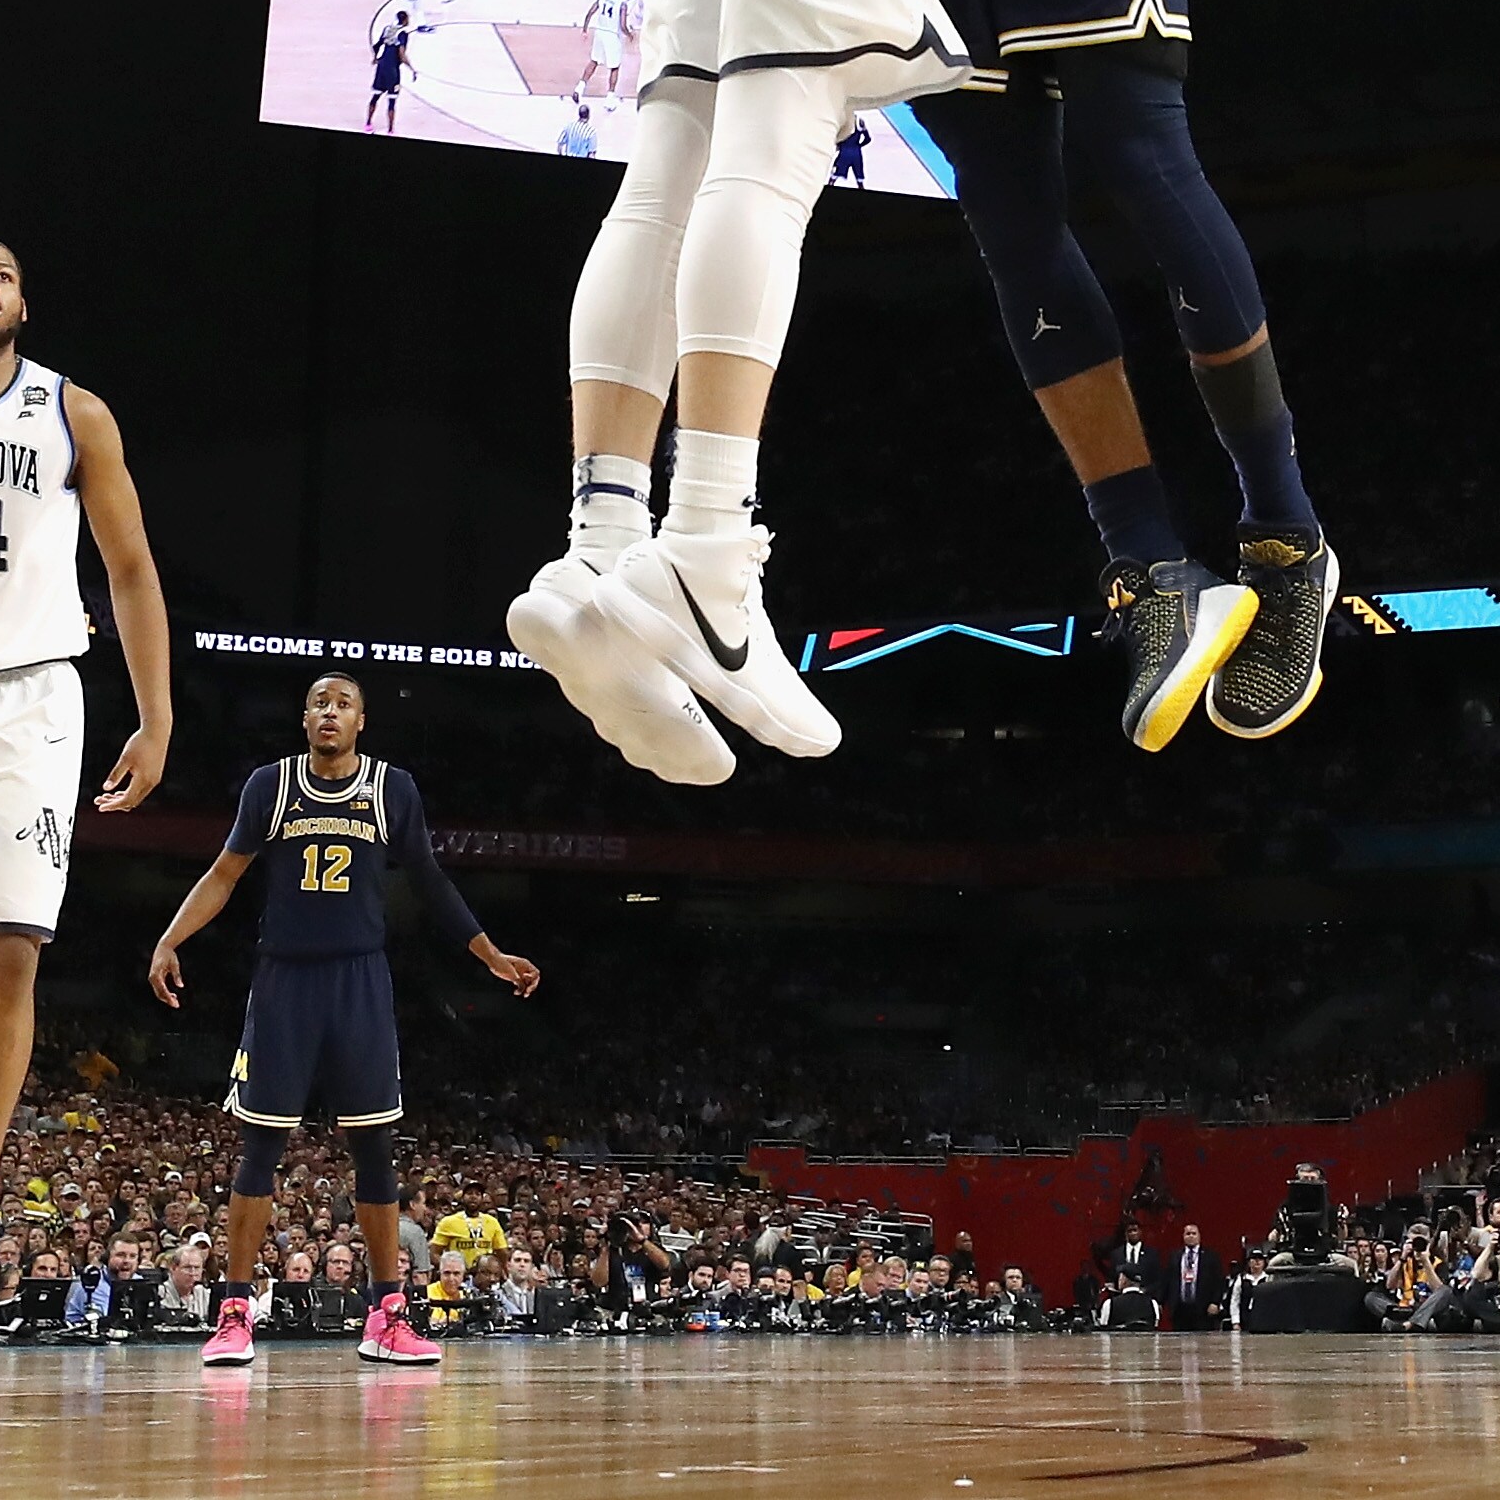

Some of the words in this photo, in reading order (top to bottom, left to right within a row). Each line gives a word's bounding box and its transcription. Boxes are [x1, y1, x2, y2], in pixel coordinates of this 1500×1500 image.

[195, 632, 324, 656] WELCOME
[331, 641, 364, 658] TO
[371, 643, 423, 662] THE
[430, 647, 492, 666] 2018
[499, 651, 542, 669] NC
[283, 817, 376, 843] MICHIGAN
[301, 844, 352, 892] 12
[230, 1048, 248, 1081] M
